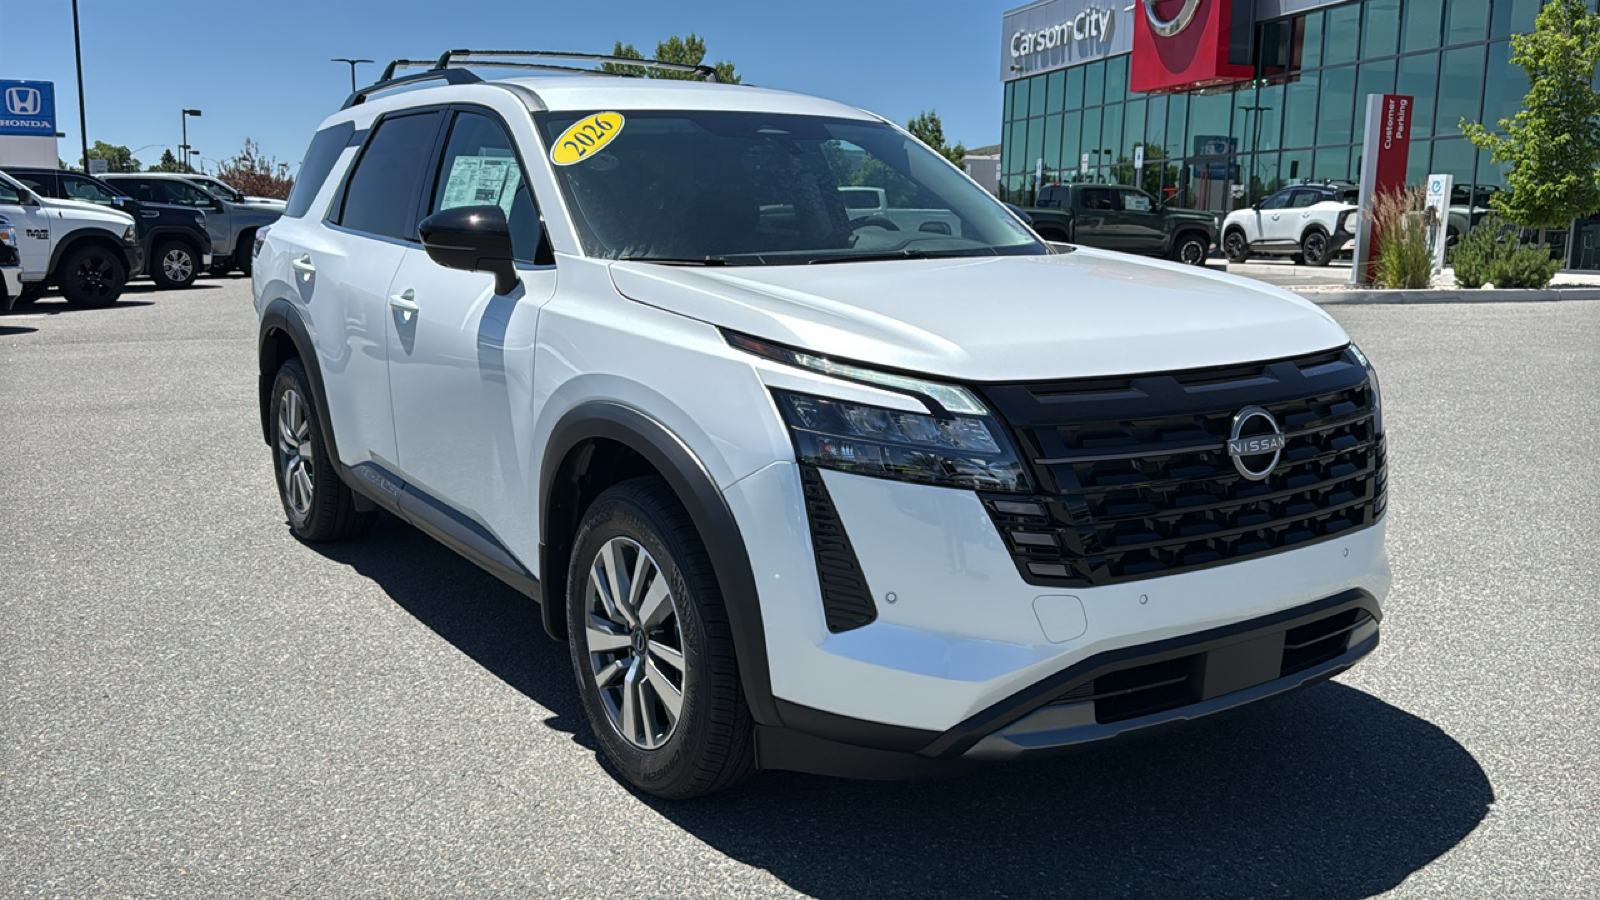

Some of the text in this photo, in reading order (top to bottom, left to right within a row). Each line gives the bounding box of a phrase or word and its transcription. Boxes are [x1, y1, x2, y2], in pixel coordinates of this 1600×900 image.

[1010, 7, 1112, 57] Carson City
[0, 119, 52, 128] HONDA
[563, 115, 614, 157] 2026
[1384, 98, 1395, 149] Customer
[1395, 99, 1408, 139] Parking
[1229, 435, 1285, 453] NISSAN
